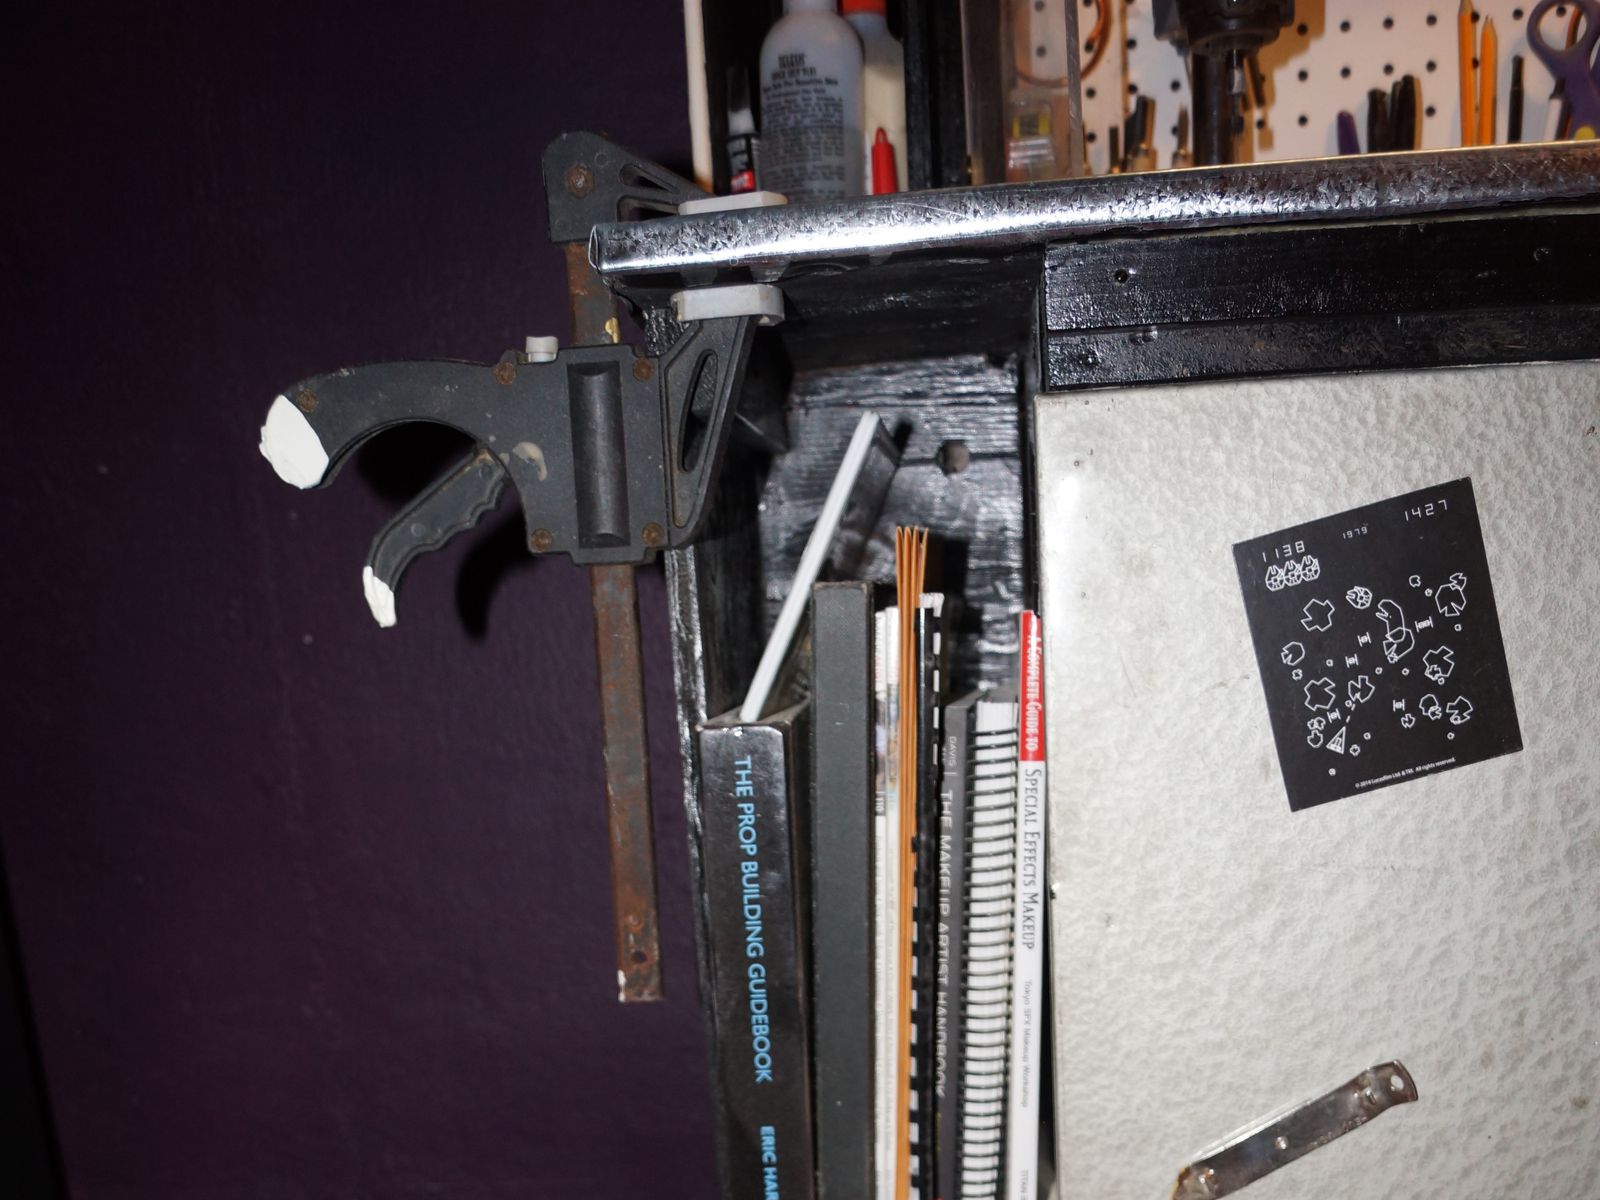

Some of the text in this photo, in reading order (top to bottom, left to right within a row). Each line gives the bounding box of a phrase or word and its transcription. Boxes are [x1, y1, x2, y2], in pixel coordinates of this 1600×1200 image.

[1404, 499, 1449, 521] 1427
[1342, 526, 1368, 539] 1979
[1262, 541, 1305, 561] 1138
[1026, 702, 1042, 733] GUIDE
[948, 735, 957, 767] DAVIS
[1026, 737, 1039, 751] TO
[939, 789, 953, 828] THE
[938, 834, 952, 915] MAKEUP
[1022, 769, 1042, 949] SPECIAL EFFECTS MAKEUP
[734, 756, 774, 1083] THE PROP BUILDING GUIDEBOOK
[936, 922, 950, 985] ARTIST
[1023, 979, 1032, 1005] Tokyo
[1021, 1027, 1031, 1062] Makeup
[1020, 1064, 1031, 1107] Workshop
[760, 1126, 777, 1162] ERIC
[1019, 1169, 1028, 1193] TITAN
